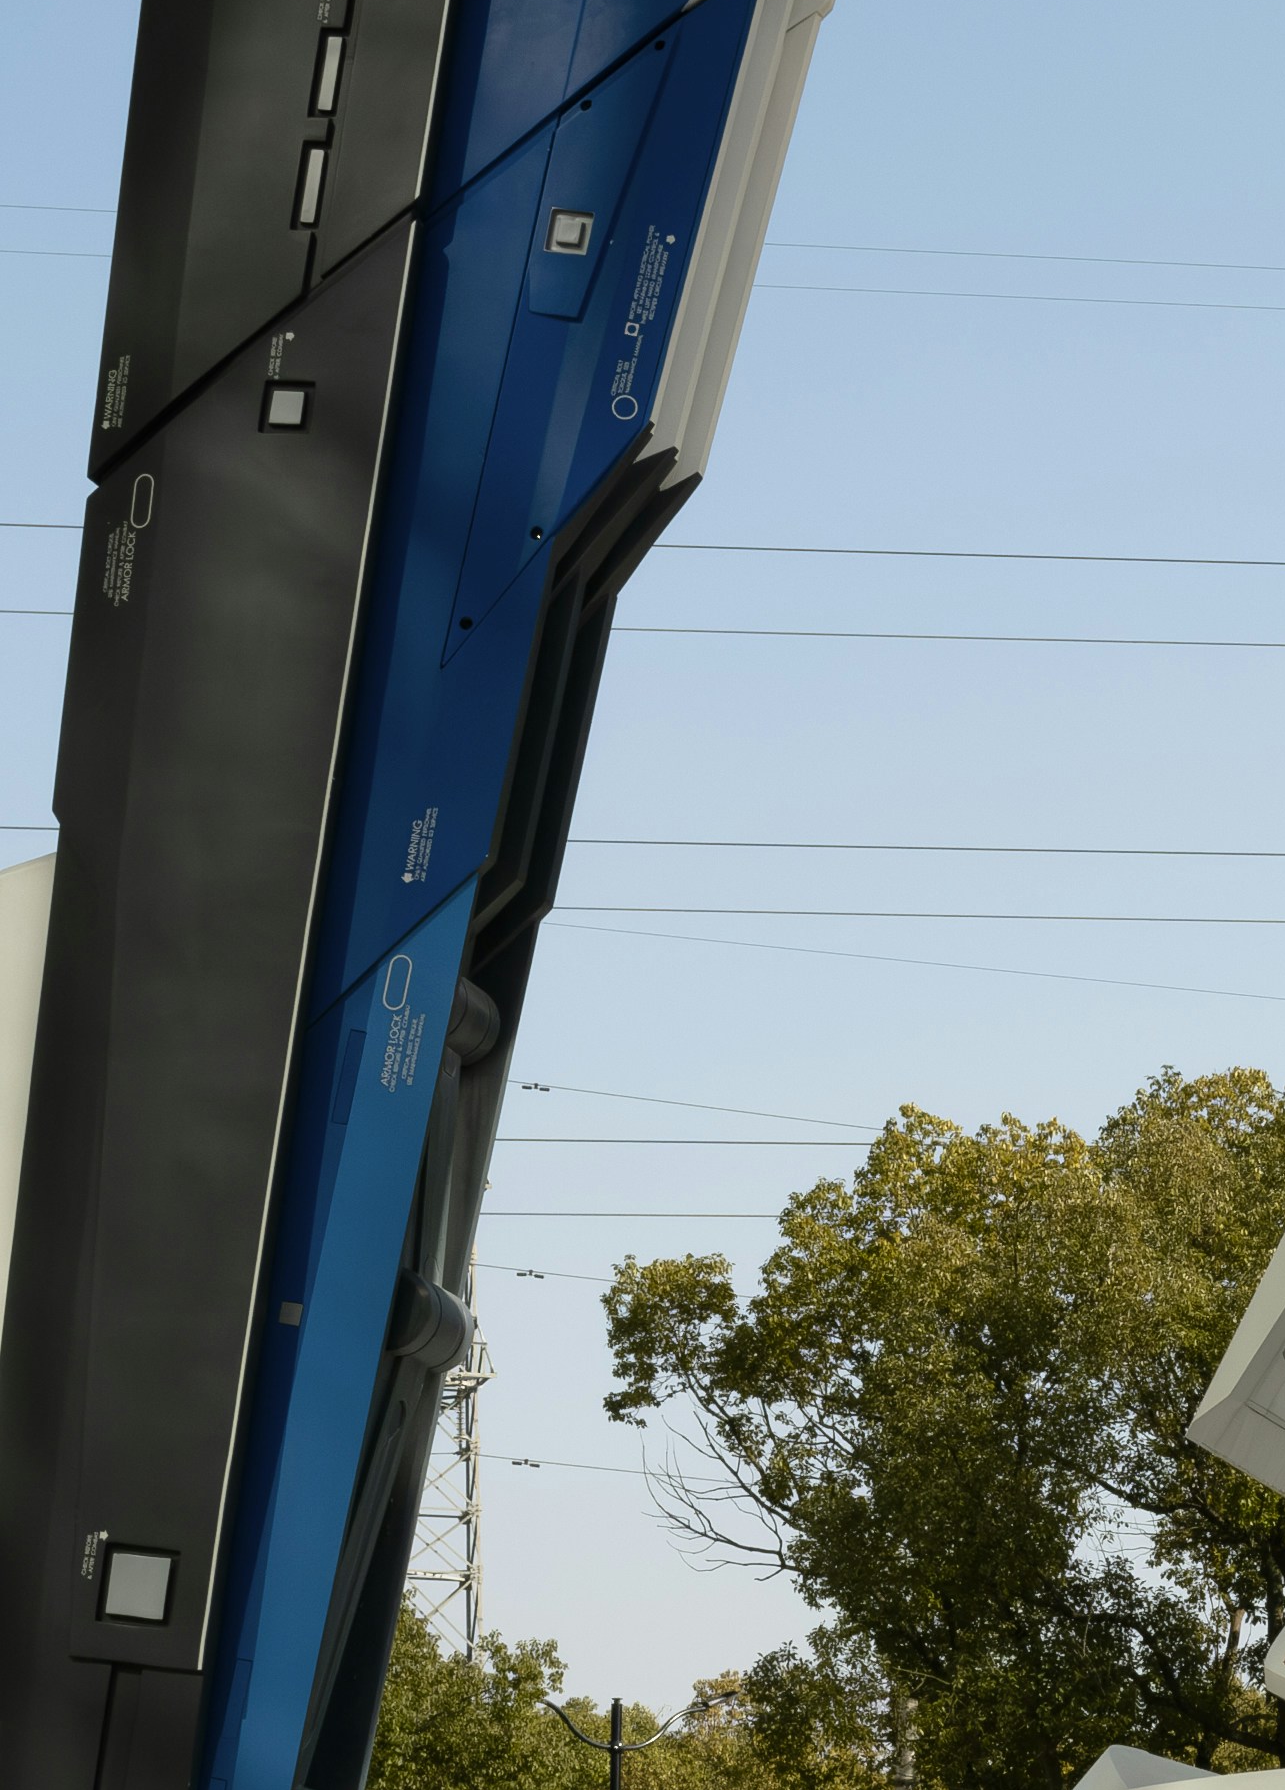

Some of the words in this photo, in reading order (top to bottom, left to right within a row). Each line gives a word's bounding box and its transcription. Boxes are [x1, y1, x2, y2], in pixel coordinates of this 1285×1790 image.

[102, 368, 118, 419] WARNING
[124, 530, 137, 560] LOCK
[119, 562, 133, 601] ARMOR
[404, 818, 423, 871] WARNING
[387, 1012, 402, 1043] LOCK
[380, 1044, 396, 1086] ARMOR
